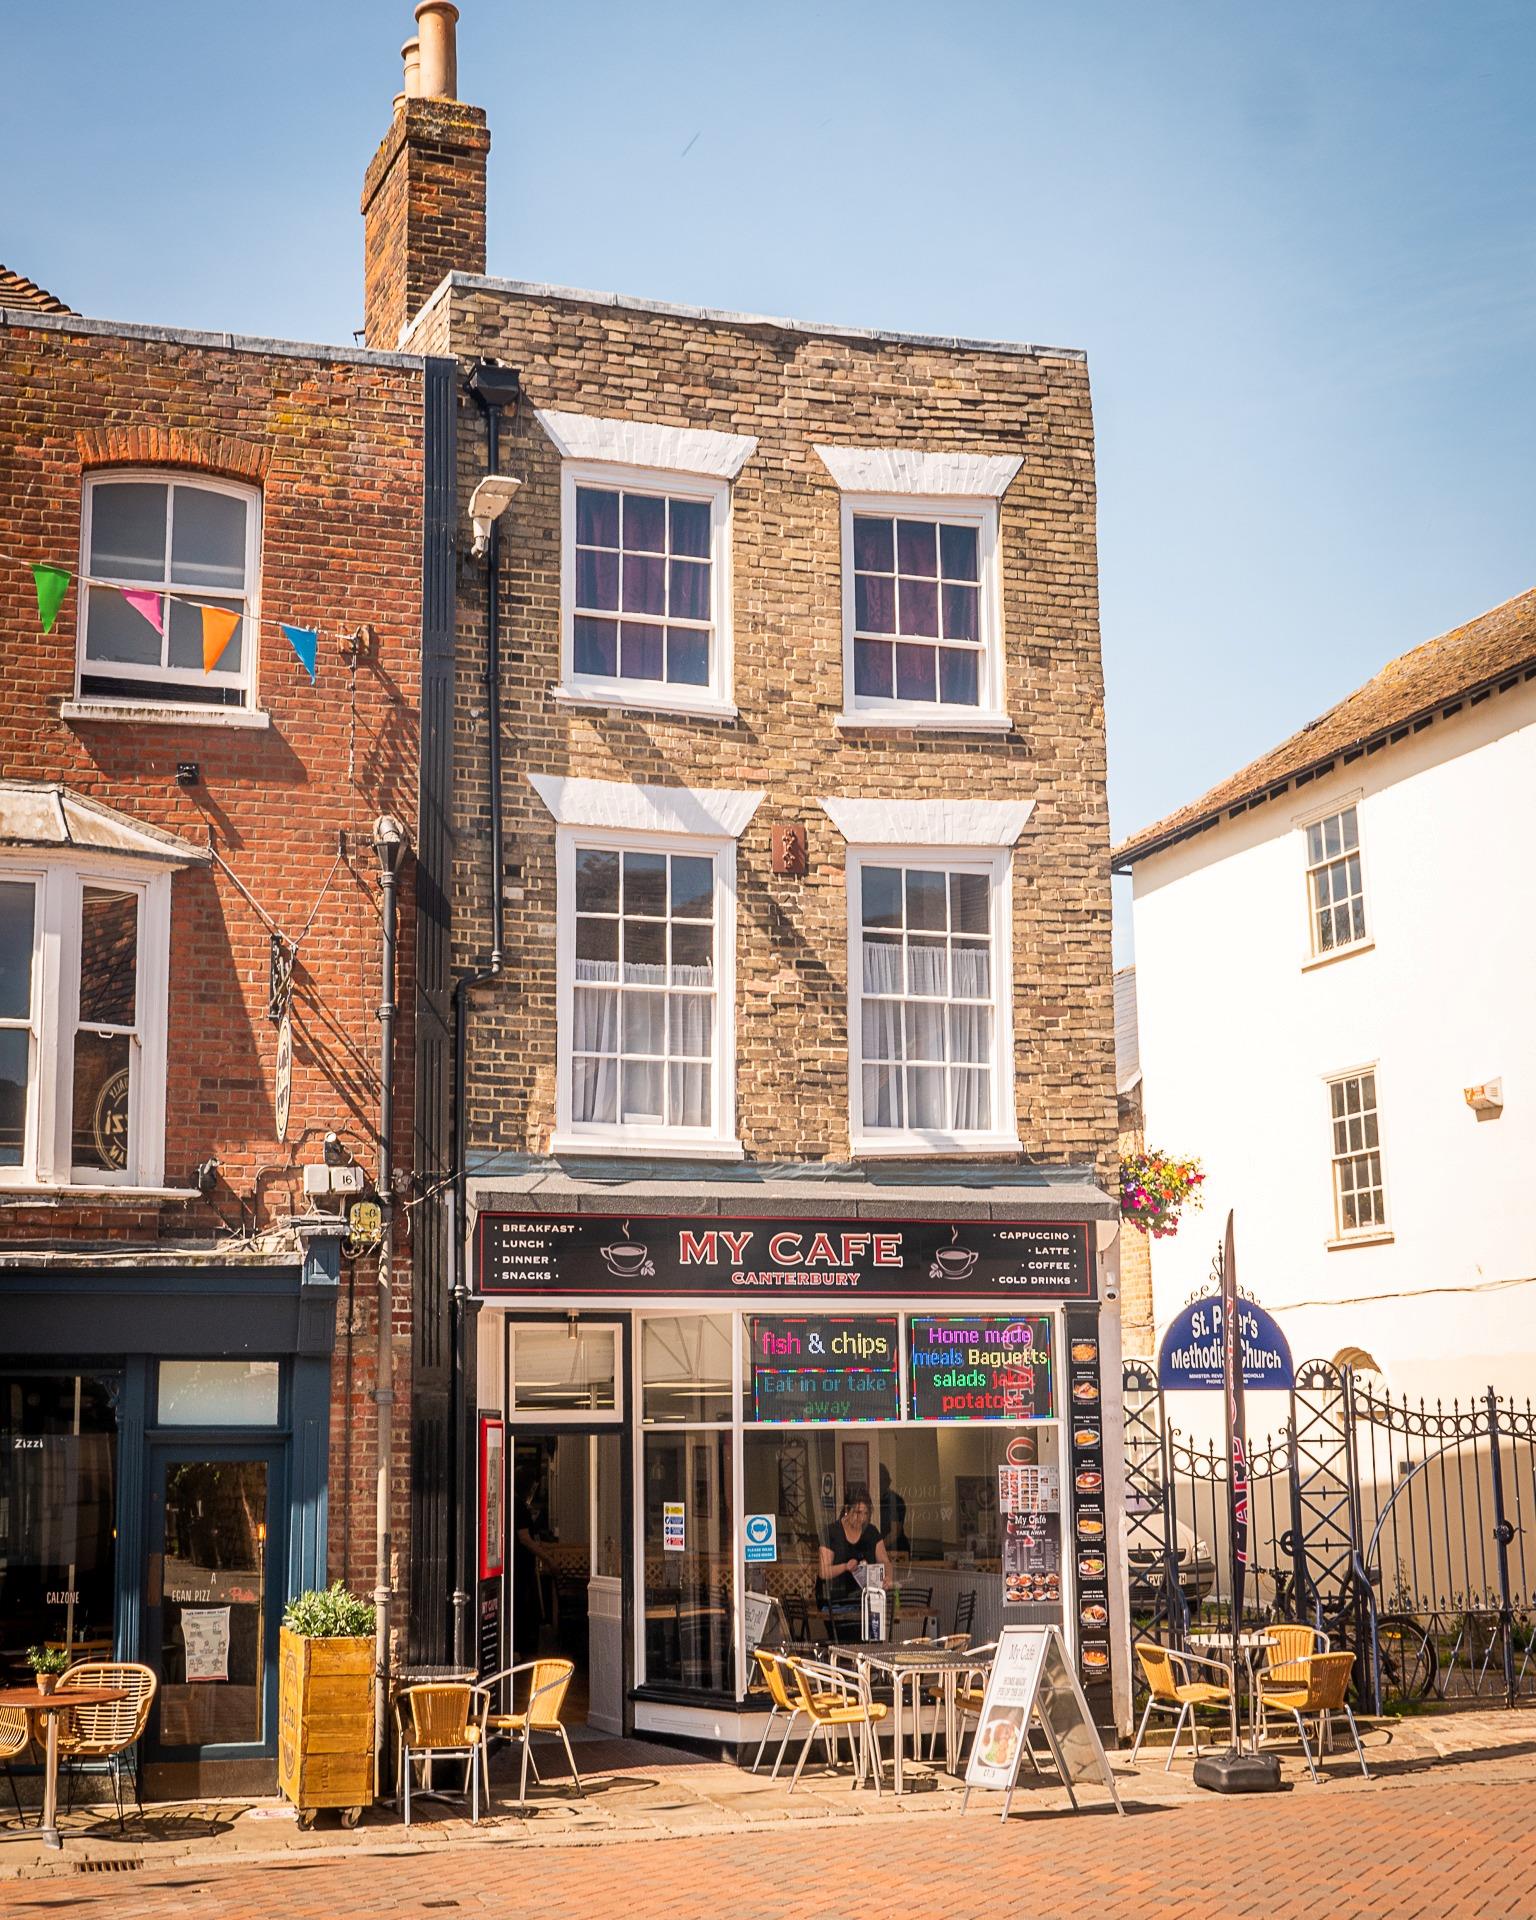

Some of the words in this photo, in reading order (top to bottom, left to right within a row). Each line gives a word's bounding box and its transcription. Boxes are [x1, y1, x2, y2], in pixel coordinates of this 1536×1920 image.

[342, 1175, 353, 1185] 16
[502, 1224, 575, 1233] BREAKFAST
[999, 1231, 1070, 1241] CAPPUCCINO
[502, 1240, 544, 1248] LUNCH
[678, 1230, 754, 1265] MY
[768, 1231, 903, 1268] CAFE
[1034, 1247, 1070, 1255] LATTE
[502, 1256, 549, 1264] DINNER
[1028, 1261, 1070, 1270] COFFEE
[502, 1271, 552, 1281] SNACKS
[731, 1272, 860, 1286] CANTERBURY
[998, 1276, 1027, 1285] COLD
[1030, 1276, 1071, 1285] DRINKS
[929, 1327, 979, 1344] Home
[984, 1327, 1031, 1344] made
[762, 1331, 801, 1355] fish
[807, 1332, 826, 1354] &
[831, 1331, 887, 1358] chips
[914, 1349, 963, 1366] meals
[968, 1349, 1048, 1367] Baguetts
[763, 1374, 793, 1392] Eat
[800, 1375, 817, 1392] in
[822, 1377, 841, 1392] or
[848, 1374, 887, 1392] take
[933, 1370, 986, 1388] salads
[803, 1399, 850, 1417] away
[14, 1438, 44, 1449] Zizzi
[46, 1592, 80, 1604] CALZONE
